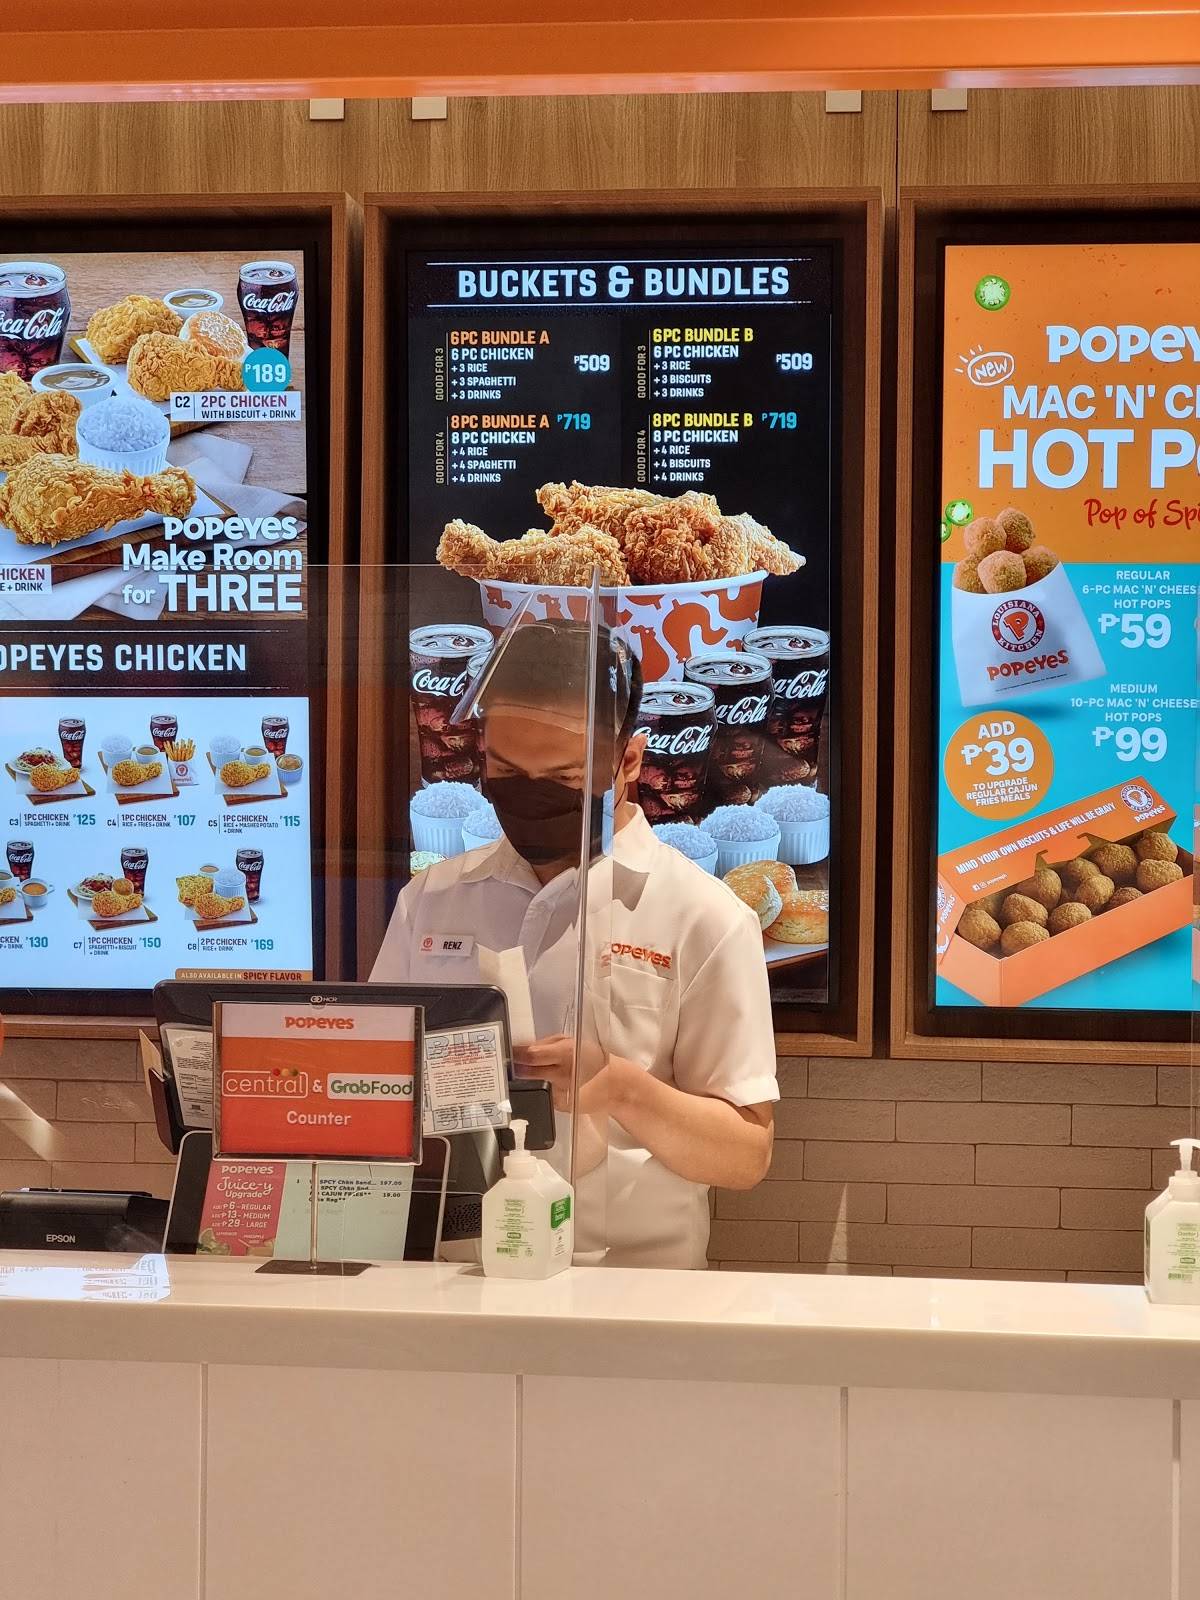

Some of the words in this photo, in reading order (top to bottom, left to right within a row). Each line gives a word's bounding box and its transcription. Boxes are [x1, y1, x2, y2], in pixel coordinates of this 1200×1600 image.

[458, 269, 597, 298] BUCKETS
[608, 265, 634, 299] &
[645, 266, 790, 296] BUNDLES
[243, 291, 295, 313] Coca-Cola
[482, 331, 536, 345] BUNDLE
[540, 331, 550, 344] A
[684, 328, 740, 342] BUNDLE
[744, 328, 754, 341] B
[451, 348, 459, 360] 6
[461, 348, 477, 360] PC
[480, 347, 534, 360] CHICKEN
[653, 346, 661, 358] 6
[664, 346, 681, 358] PC
[683, 345, 739, 358] CHICKEN
[435, 355, 444, 373] FOR
[459, 364, 465, 372] 3
[467, 363, 488, 372] RICE
[638, 352, 646, 370] FOR
[662, 361, 667, 370] 3
[670, 361, 691, 370] RICE
[459, 377, 465, 386] 3
[467, 376, 516, 386] SPAGHETTI
[662, 375, 667, 384] 3
[670, 374, 712, 384] BISCUITS
[435, 375, 444, 400] GOOD
[638, 373, 646, 399] GOOD
[662, 388, 667, 397] 3
[670, 388, 704, 397] DRINKS
[459, 390, 465, 399] 3
[467, 390, 501, 399] DRINKS
[175, 396, 190, 408] C2
[202, 396, 226, 408] 2PC
[231, 395, 287, 408] CHICKEN
[1003, 385, 1096, 419] MAC
[227, 410, 260, 418] BISCUIT
[270, 410, 296, 418] DRINK
[684, 413, 739, 427] BUNDLE
[744, 413, 753, 426] B
[482, 415, 536, 428] BUNDLE
[540, 415, 550, 428] A
[451, 432, 459, 444] 8
[462, 432, 478, 444] PC
[481, 431, 536, 443] CHICKEN
[653, 431, 661, 442] 8
[664, 431, 681, 442] PC
[683, 430, 739, 442] CHICKEN
[459, 447, 465, 456] 4
[468, 447, 488, 456] RICE
[661, 446, 667, 454] 4
[670, 445, 690, 454] RICE
[459, 461, 465, 469] 4
[467, 460, 517, 469] SPAGHETTI
[661, 460, 667, 468] 4
[670, 459, 711, 468] BISCUITS
[978, 428, 1134, 489] HOT
[459, 474, 465, 483] 4
[468, 474, 501, 483] DRINKS
[661, 473, 667, 481] 4
[670, 472, 704, 481] DRINKS
[1084, 499, 1127, 530] Pop
[1133, 499, 1157, 530] of
[123, 543, 206, 571] Make
[214, 543, 303, 571] Room
[1116, 570, 1170, 580] REGULAR
[122, 585, 155, 604] for
[159, 574, 303, 612] THREE
[1082, 585, 1111, 595] 6-PC
[1113, 585, 1138, 595] MAC
[1159, 585, 1197, 595] CHEES
[1114, 599, 1138, 609] HOT
[1140, 599, 1171, 609] POPS
[115, 644, 246, 671] CHICKEN
[1110, 684, 1158, 694] MEDIUM
[1071, 698, 1104, 708] 10-PC
[1107, 698, 1132, 708] MAC
[1105, 712, 1129, 722] HOT
[1132, 712, 1162, 722] POPS
[978, 720, 1015, 739] ADD
[973, 783, 986, 791] TO
[987, 776, 1029, 790] UPGRADE
[966, 789, 1007, 801] REGULAR
[1008, 784, 1038, 794] CAJUN
[975, 798, 999, 806] FRIES
[1001, 792, 1031, 803] MEALS
[956, 859, 979, 874] MIND
[977, 850, 1001, 864] YOUR
[1000, 841, 1020, 855] OWN
[1017, 829, 1051, 849] BISCUITS
[1055, 820, 1072, 833] LIFE
[443, 941, 462, 950] RENZ
[227, 1076, 303, 1093] central
[312, 1080, 322, 1092] &
[331, 1080, 413, 1095] GrabFood
[287, 1111, 351, 1126] Counter
[46, 1234, 75, 1243] EPSON
